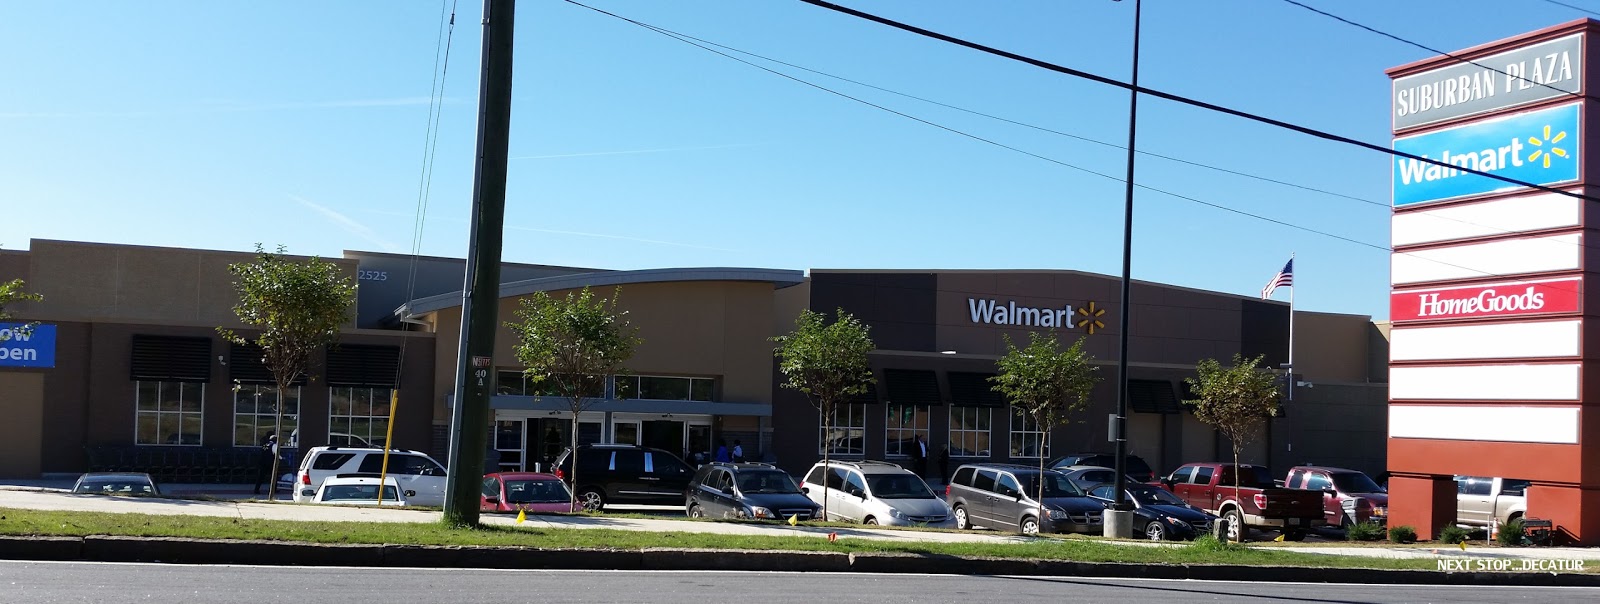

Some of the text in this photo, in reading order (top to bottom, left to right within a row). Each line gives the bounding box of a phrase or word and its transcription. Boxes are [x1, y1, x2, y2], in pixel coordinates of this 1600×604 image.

[1397, 51, 1573, 117] SUBURBAN PLAZA
[1398, 137, 1524, 186] Walmart
[359, 270, 387, 281] 2525
[968, 297, 1075, 329] Walmart
[1417, 286, 1545, 317] HomeGoods
[0, 327, 32, 342] ow
[475, 369, 487, 378] 40
[477, 377, 484, 386] A
